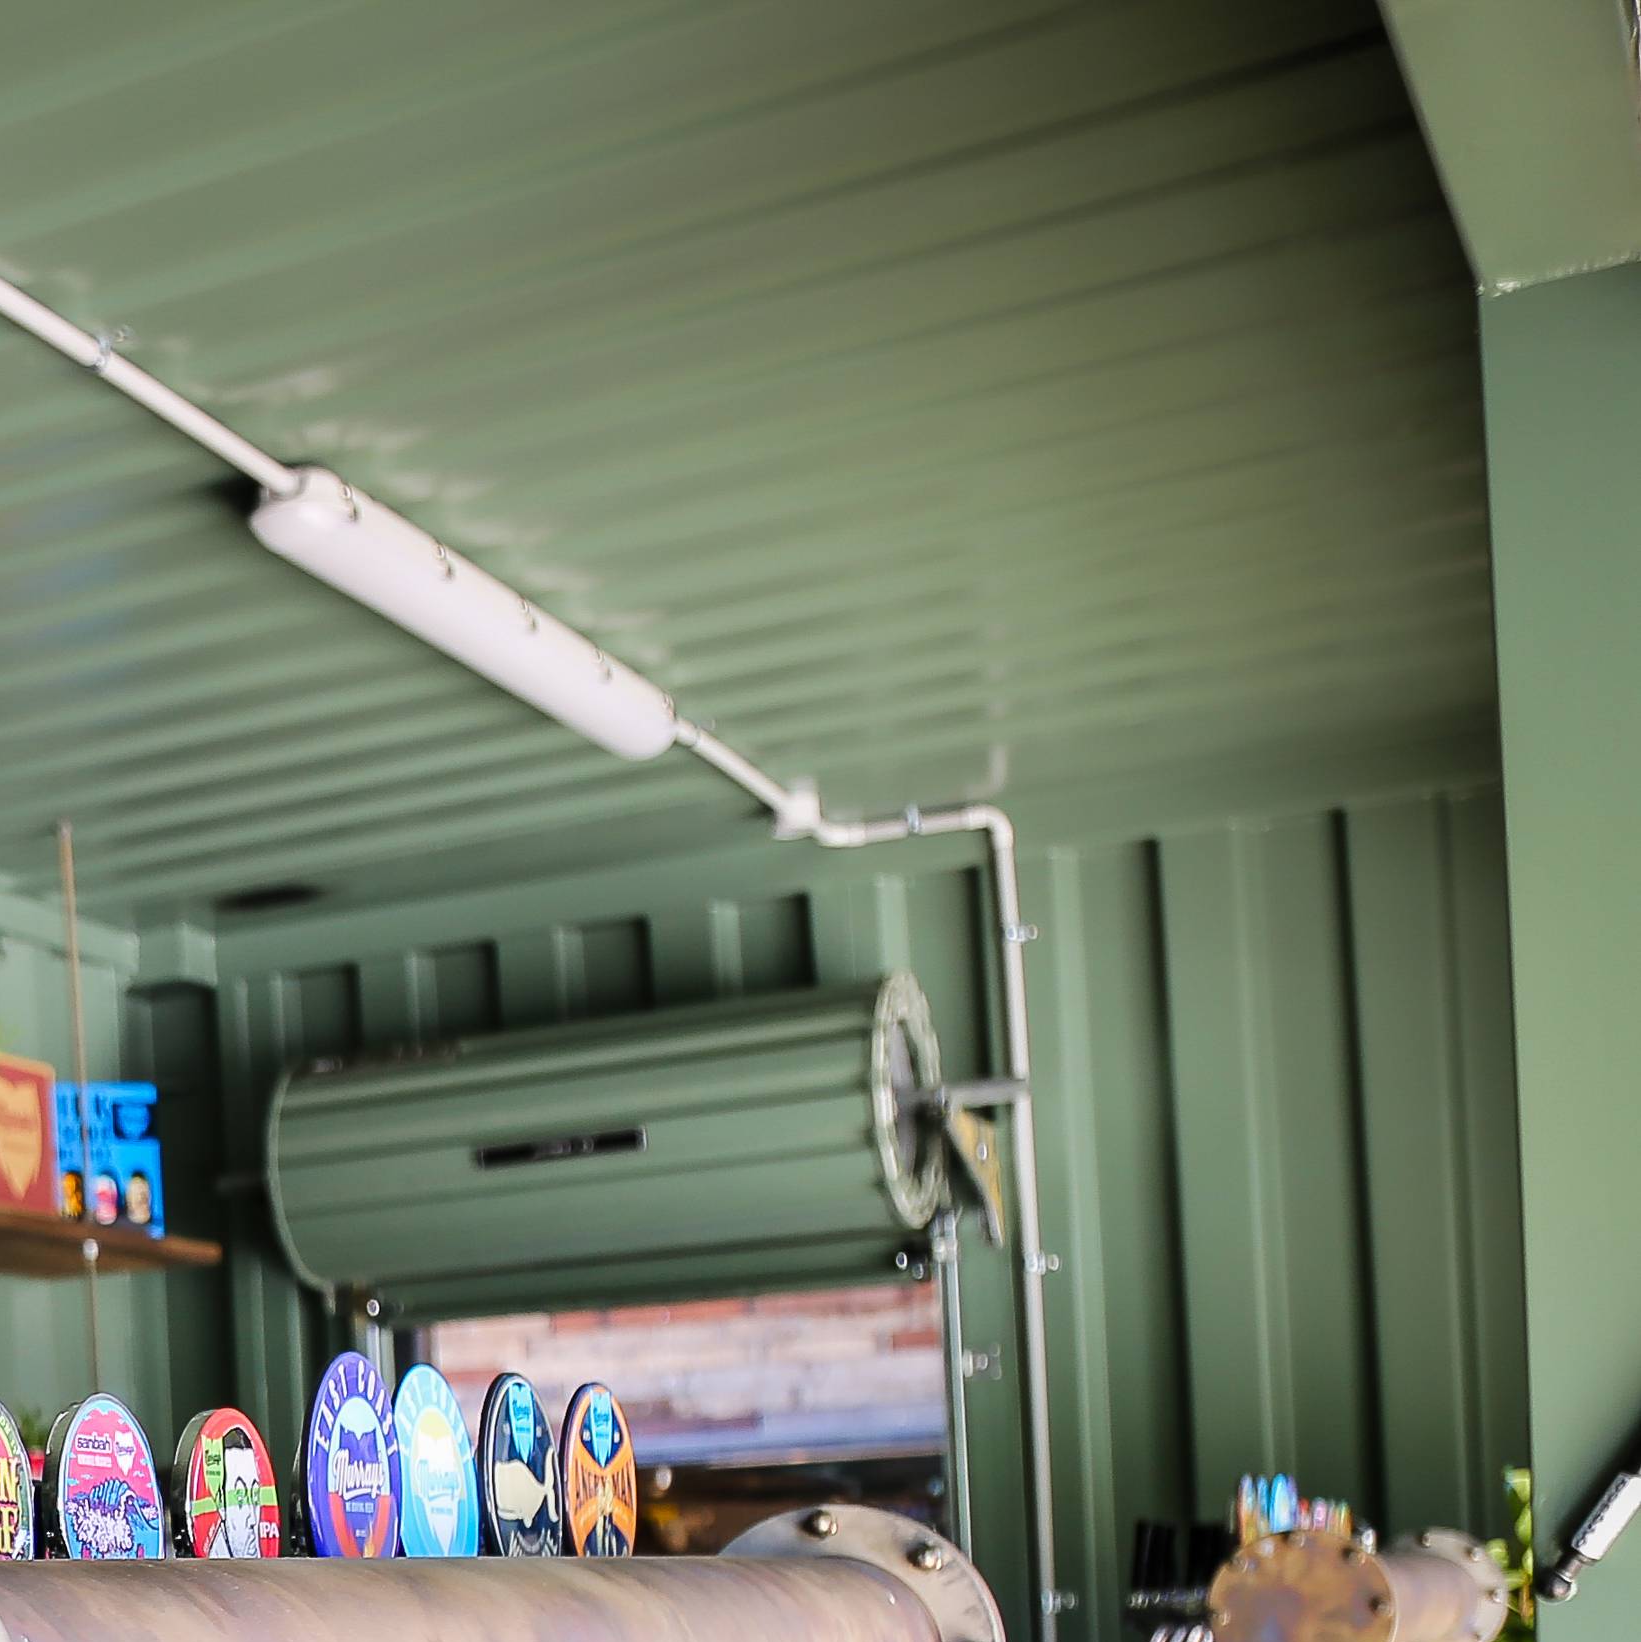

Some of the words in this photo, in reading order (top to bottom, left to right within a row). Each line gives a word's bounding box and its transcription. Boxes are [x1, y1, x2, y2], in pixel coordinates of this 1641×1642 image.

[315, 1363, 348, 1453] EAST
[358, 1359, 398, 1456] COAST
[77, 1435, 111, 1451] sanbah
[333, 1448, 384, 1500] Murray's
[260, 1522, 280, 1538] IPA
